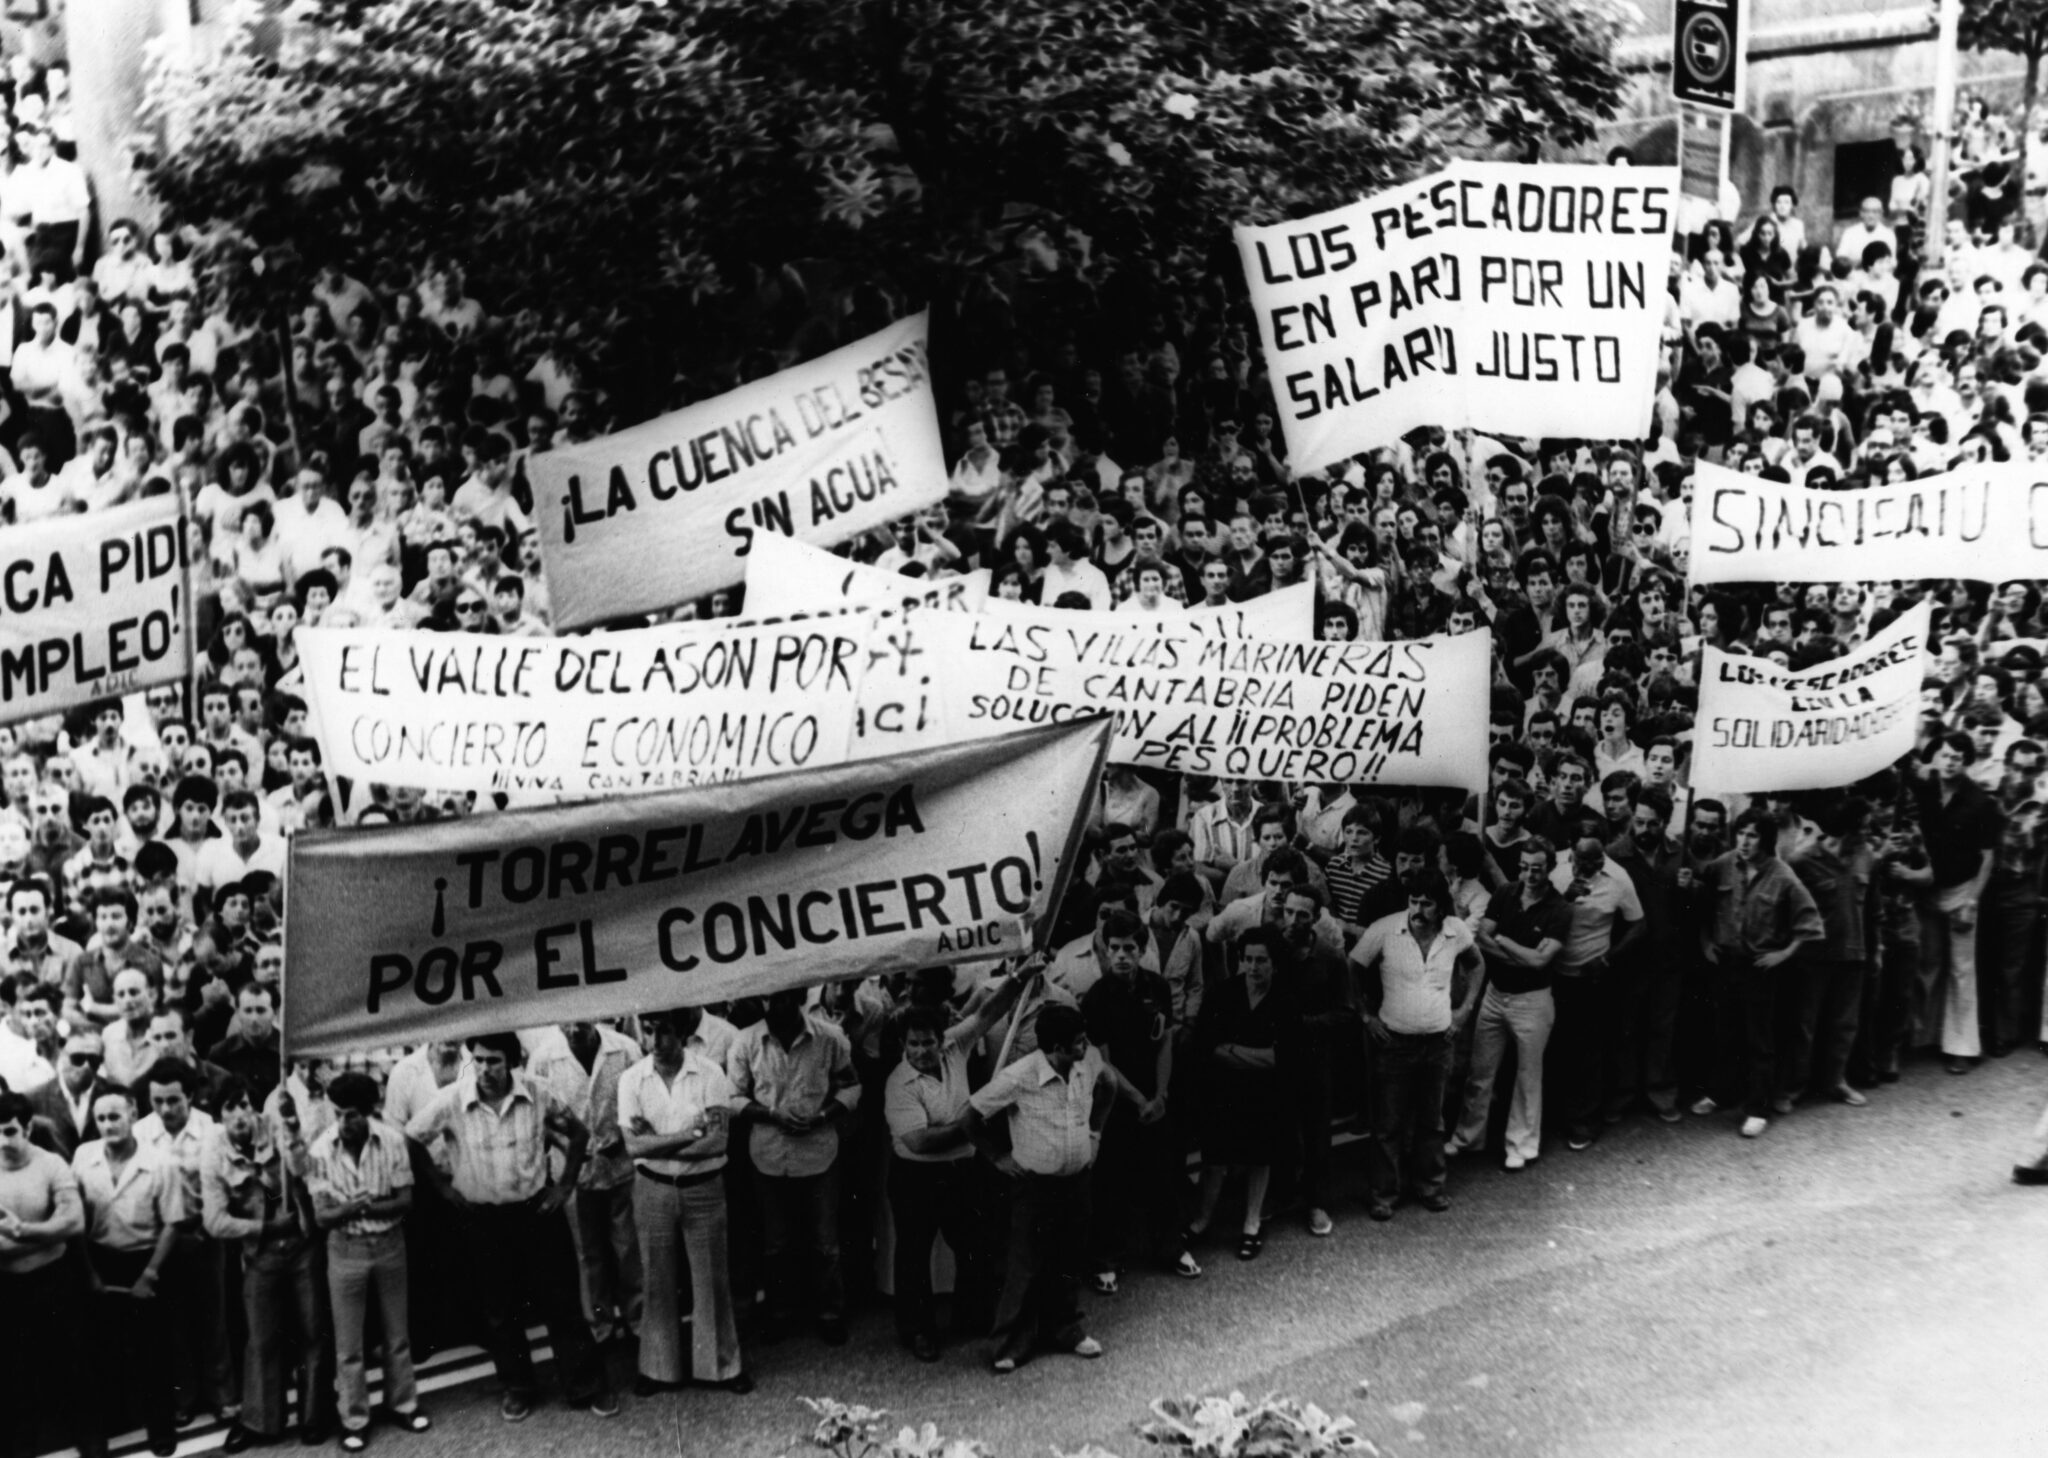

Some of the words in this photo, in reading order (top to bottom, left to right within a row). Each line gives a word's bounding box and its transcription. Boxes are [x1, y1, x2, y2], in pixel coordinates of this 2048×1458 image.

[1256, 224, 1356, 284] LOS
[1372, 180, 1669, 249] PESCADORES
[1271, 294, 1336, 351] EN
[1481, 256, 1562, 307] POR
[1587, 260, 1645, 309] UN
[1476, 331, 1620, 382] JUSTO
[648, 408, 796, 500] CUENCA
[794, 381, 861, 439] DEL
[725, 491, 794, 556] SIN
[340, 645, 389, 695] EL
[410, 646, 541, 697] VALLE
[555, 648, 630, 693] DEL
[643, 638, 757, 694] ASON
[771, 633, 857, 693] POR
[970, 621, 1051, 661] LAS
[1067, 628, 1188, 670] VILLAS
[1199, 640, 1433, 681] MARINERAS
[1007, 665, 1057, 696] DE
[1084, 675, 1294, 710] CANTABRIA
[1322, 682, 1425, 717] PIDEN
[1838, 686, 1874, 708] LA
[353, 715, 547, 767] CONCIERTO
[581, 713, 817, 767] ECONOMICO
[1166, 713, 1217, 745] AL
[367, 940, 503, 1013] POR
[535, 920, 626, 989] EL
[657, 830, 1043, 972] CONCIERTO!
[937, 928, 1000, 953] ADIC
